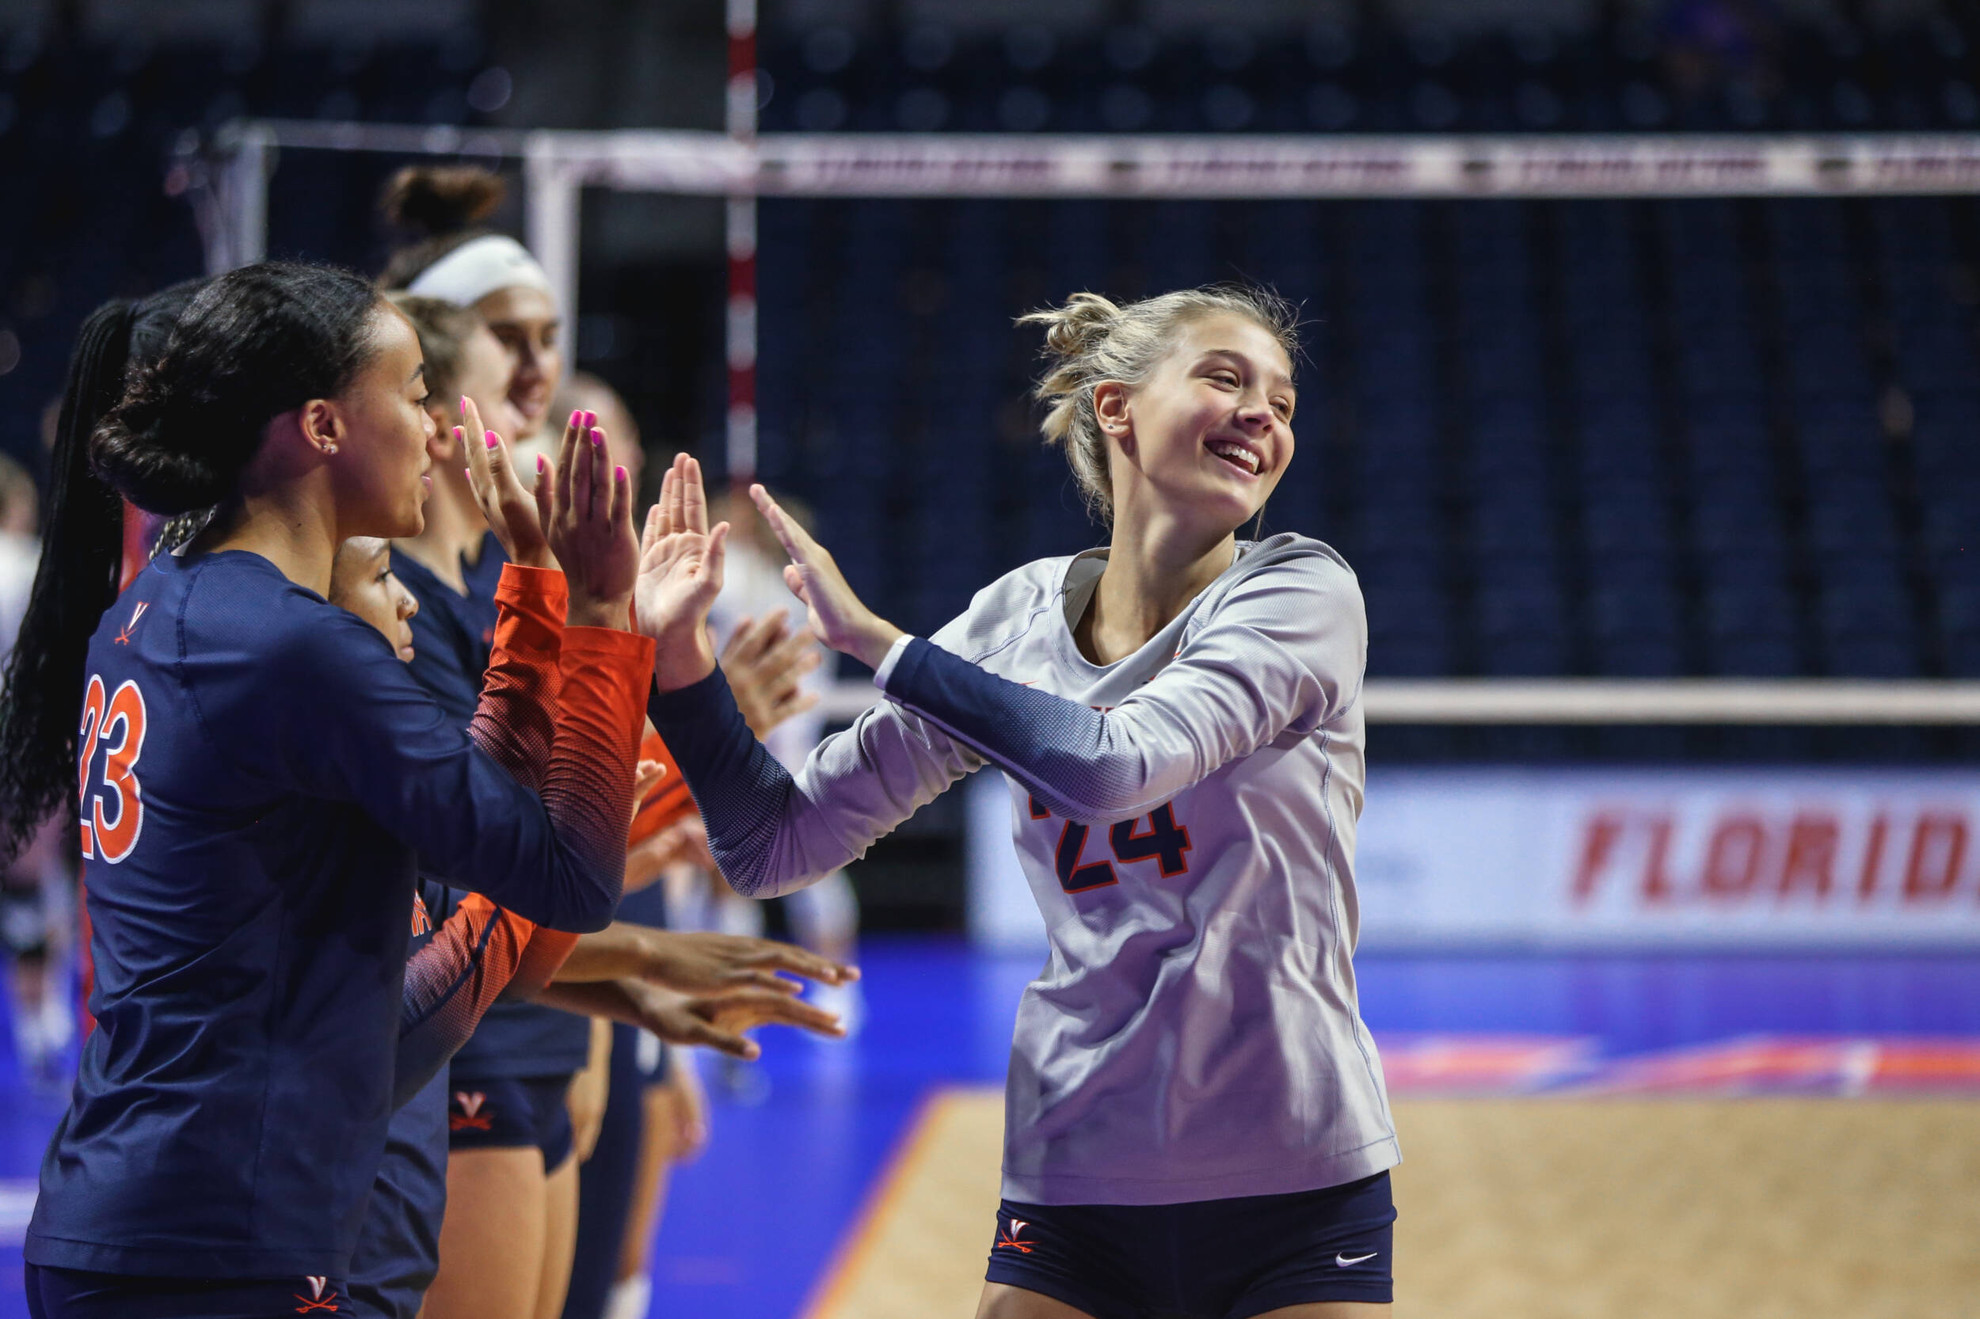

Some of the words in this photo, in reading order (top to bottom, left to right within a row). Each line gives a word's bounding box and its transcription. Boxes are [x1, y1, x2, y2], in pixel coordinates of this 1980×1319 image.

[79, 673, 148, 865] 23
[1028, 794, 1193, 895] 24
[1569, 809, 1980, 906] FLORID
